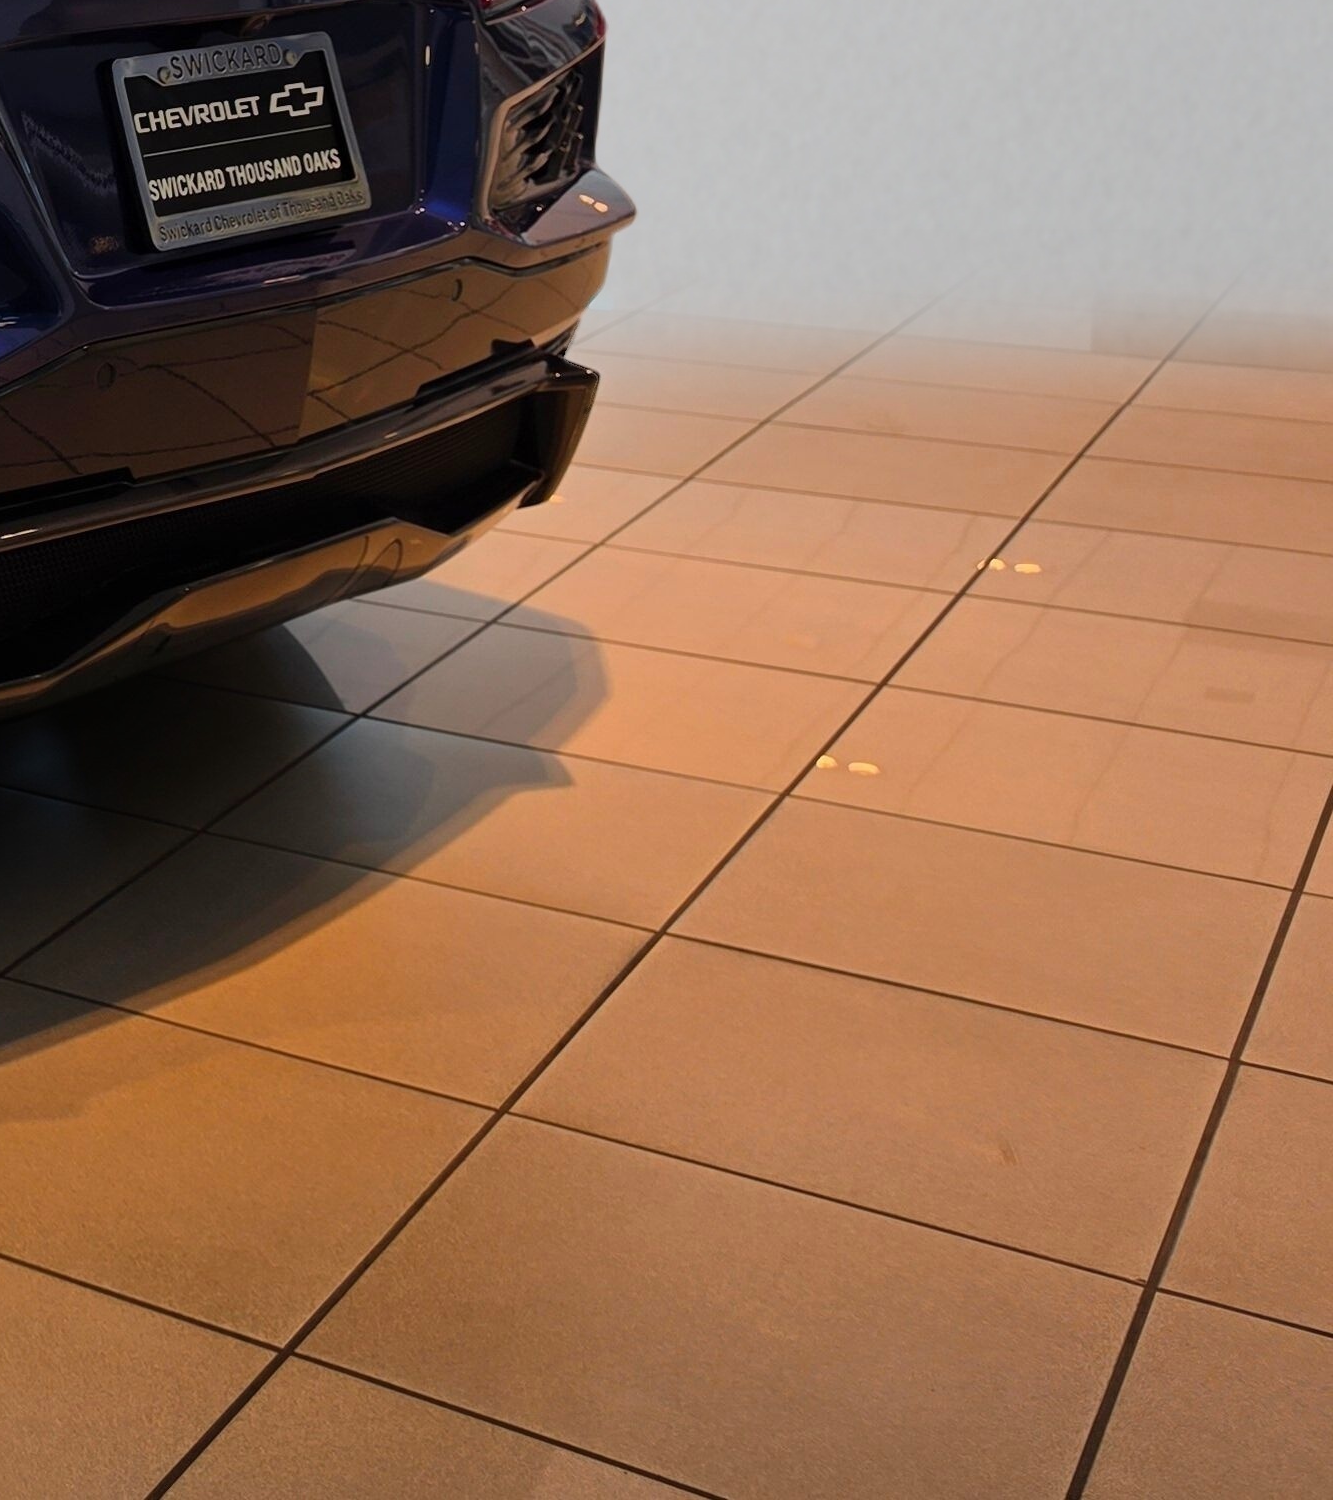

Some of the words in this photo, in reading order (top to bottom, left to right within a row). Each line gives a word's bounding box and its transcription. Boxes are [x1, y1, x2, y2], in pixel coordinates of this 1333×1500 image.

[169, 43, 282, 79] SWICKARD
[133, 95, 260, 134] CHEVROLET
[148, 168, 226, 202] SWICKARD
[226, 155, 302, 187] THOUSAND
[303, 147, 342, 174] OAKS
[159, 216, 213, 243] Swickard
[214, 209, 269, 231] Chevrolet
[269, 203, 281, 220] of
[283, 193, 336, 217] Thousand
[336, 190, 366, 209] Oaks
